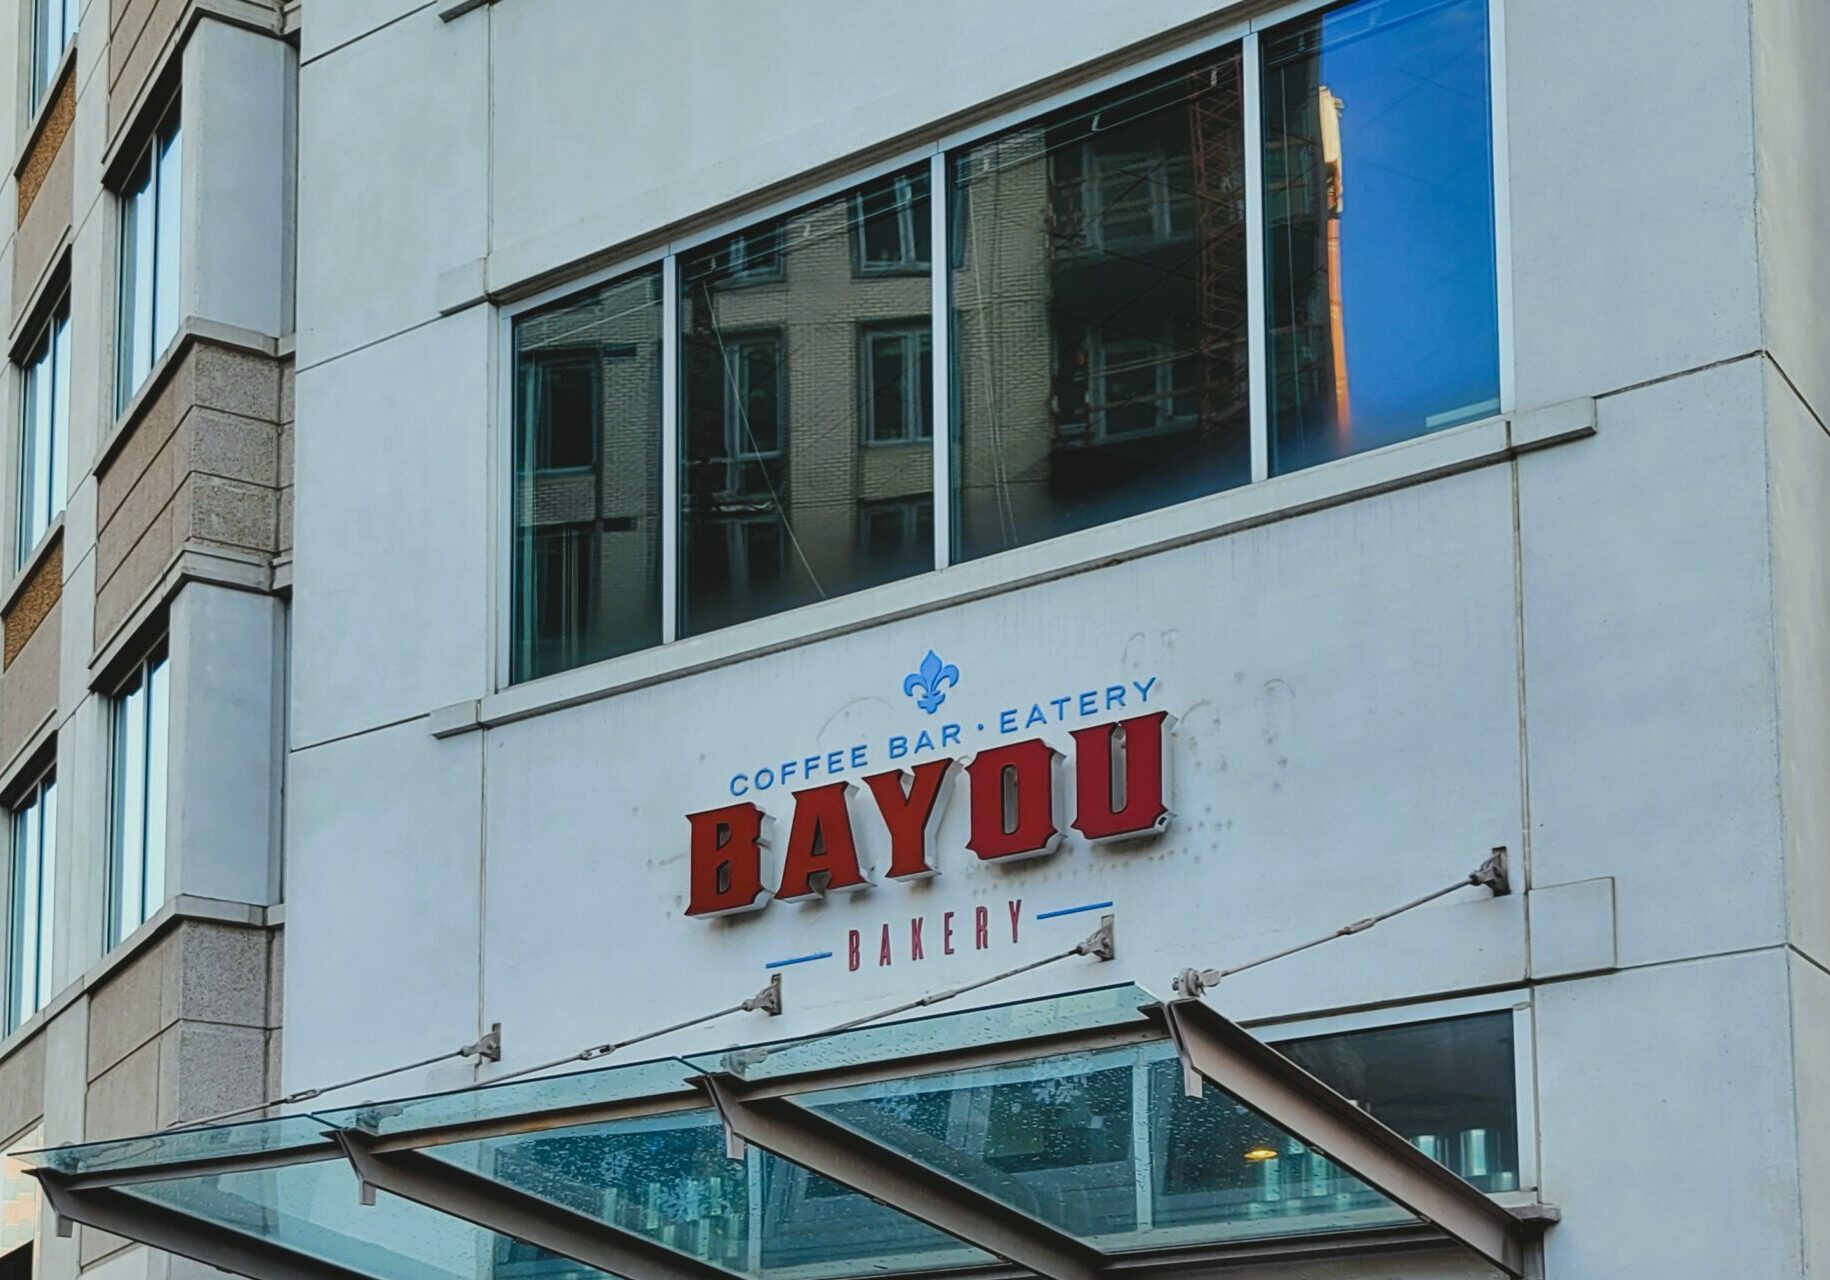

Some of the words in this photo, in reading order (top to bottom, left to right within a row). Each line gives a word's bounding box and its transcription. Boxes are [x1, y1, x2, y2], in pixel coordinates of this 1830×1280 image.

[729, 744, 868, 797] COFFEE
[888, 723, 962, 760] BAR
[1000, 676, 1157, 734] EATERY
[684, 710, 1174, 919] BAYOU
[848, 899, 1023, 972] BAKERY
